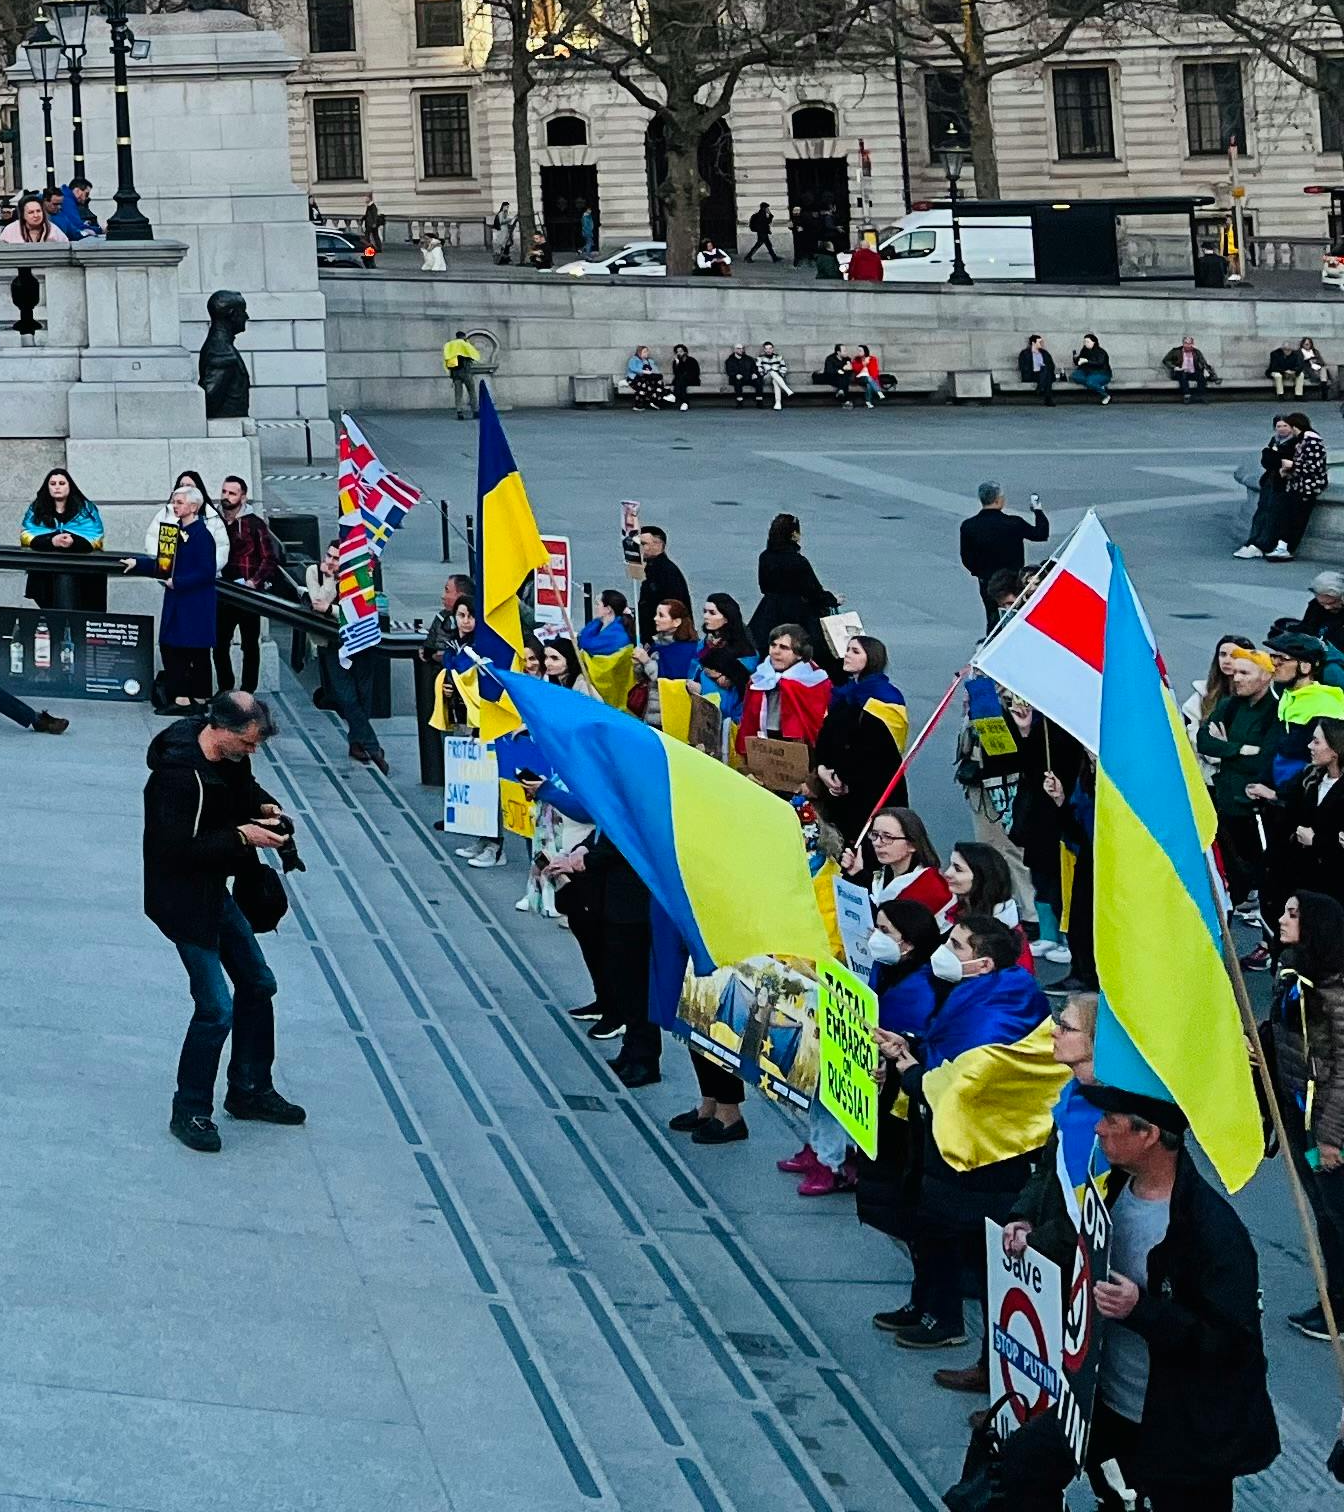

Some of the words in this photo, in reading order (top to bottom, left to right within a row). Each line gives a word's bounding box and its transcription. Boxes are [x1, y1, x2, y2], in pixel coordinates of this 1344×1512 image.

[447, 783, 470, 805] SAVE
[825, 972, 869, 1035] TOTAL
[826, 1007, 873, 1077] EMBARGO
[842, 1056, 852, 1077] ON
[828, 1061, 869, 1130] RUSSIA!
[995, 1328, 1019, 1367] STOP
[1023, 1352, 1056, 1396] PUTIN
